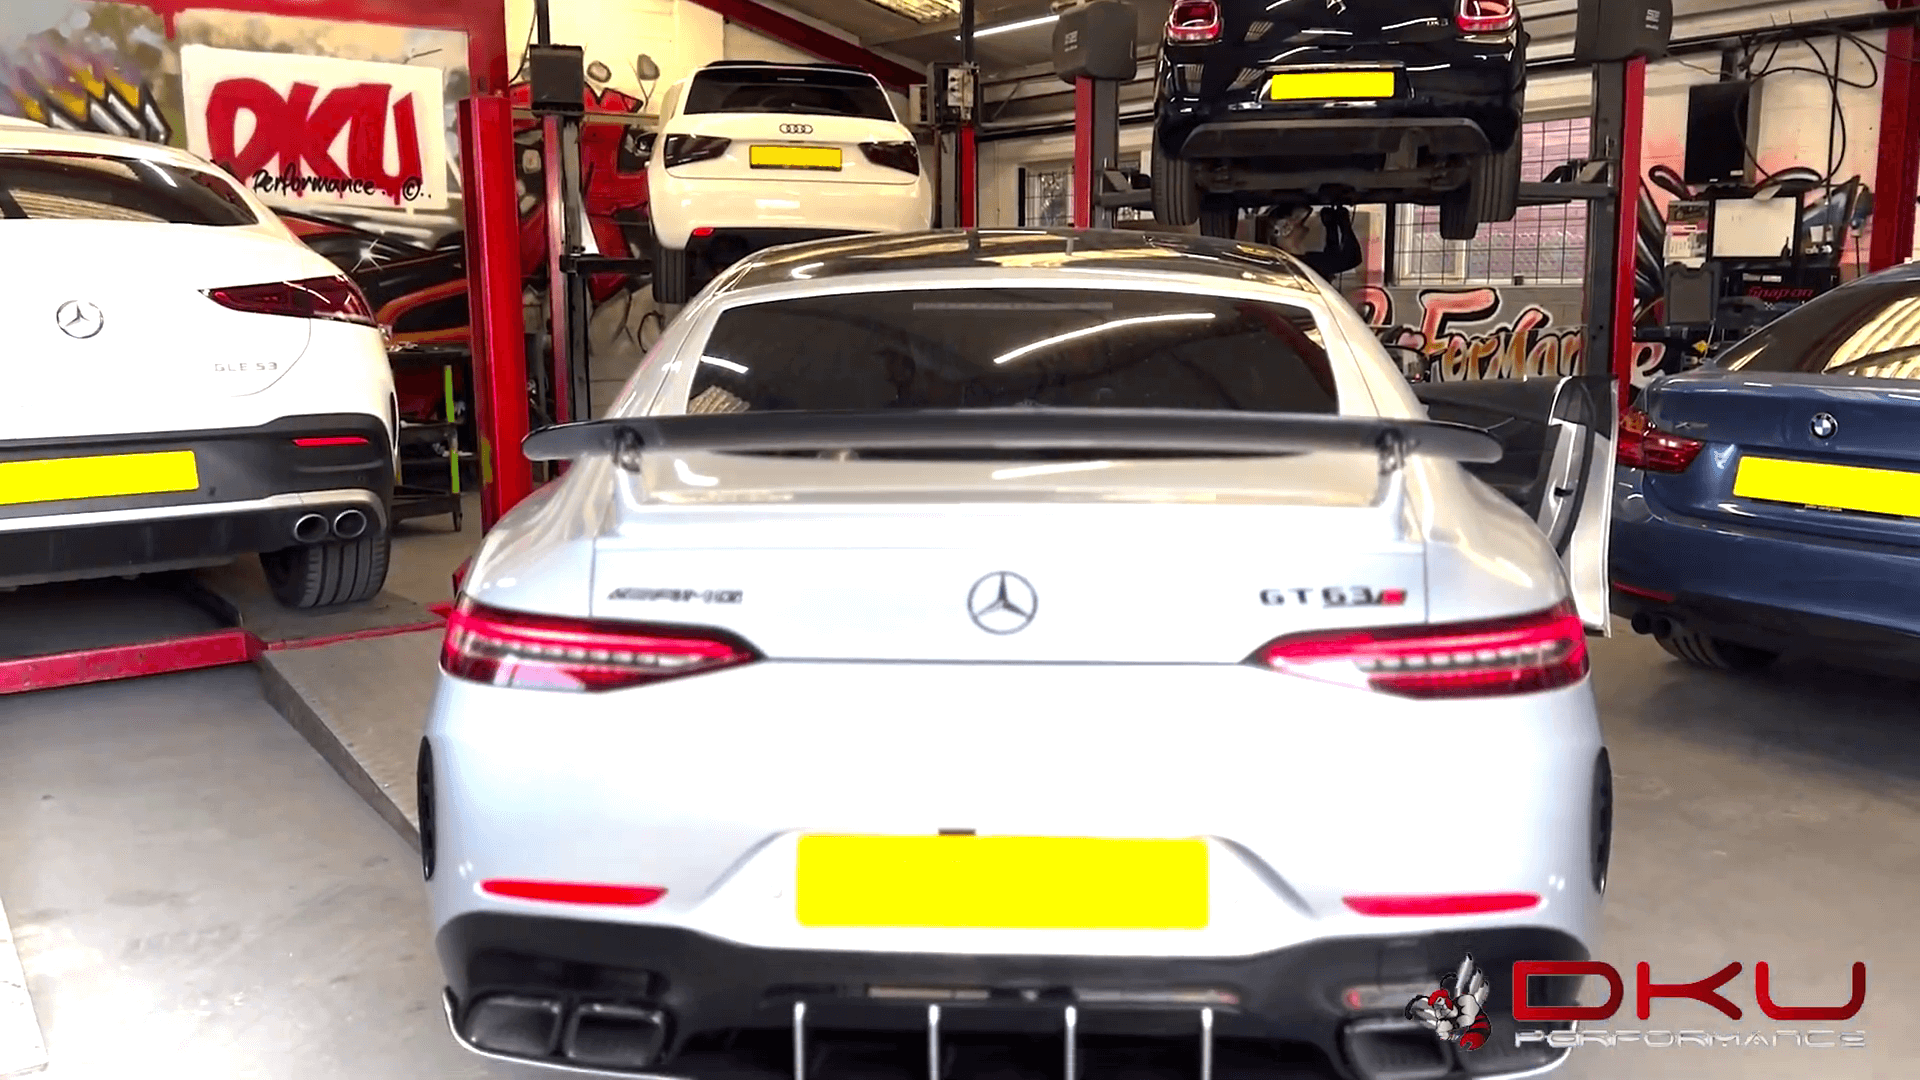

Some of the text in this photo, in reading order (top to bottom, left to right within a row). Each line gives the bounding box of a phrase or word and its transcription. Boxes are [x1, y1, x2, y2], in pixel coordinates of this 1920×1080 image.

[206, 78, 422, 200] DKU
[214, 362, 248, 372] GLE
[1259, 588, 1314, 606] GT
